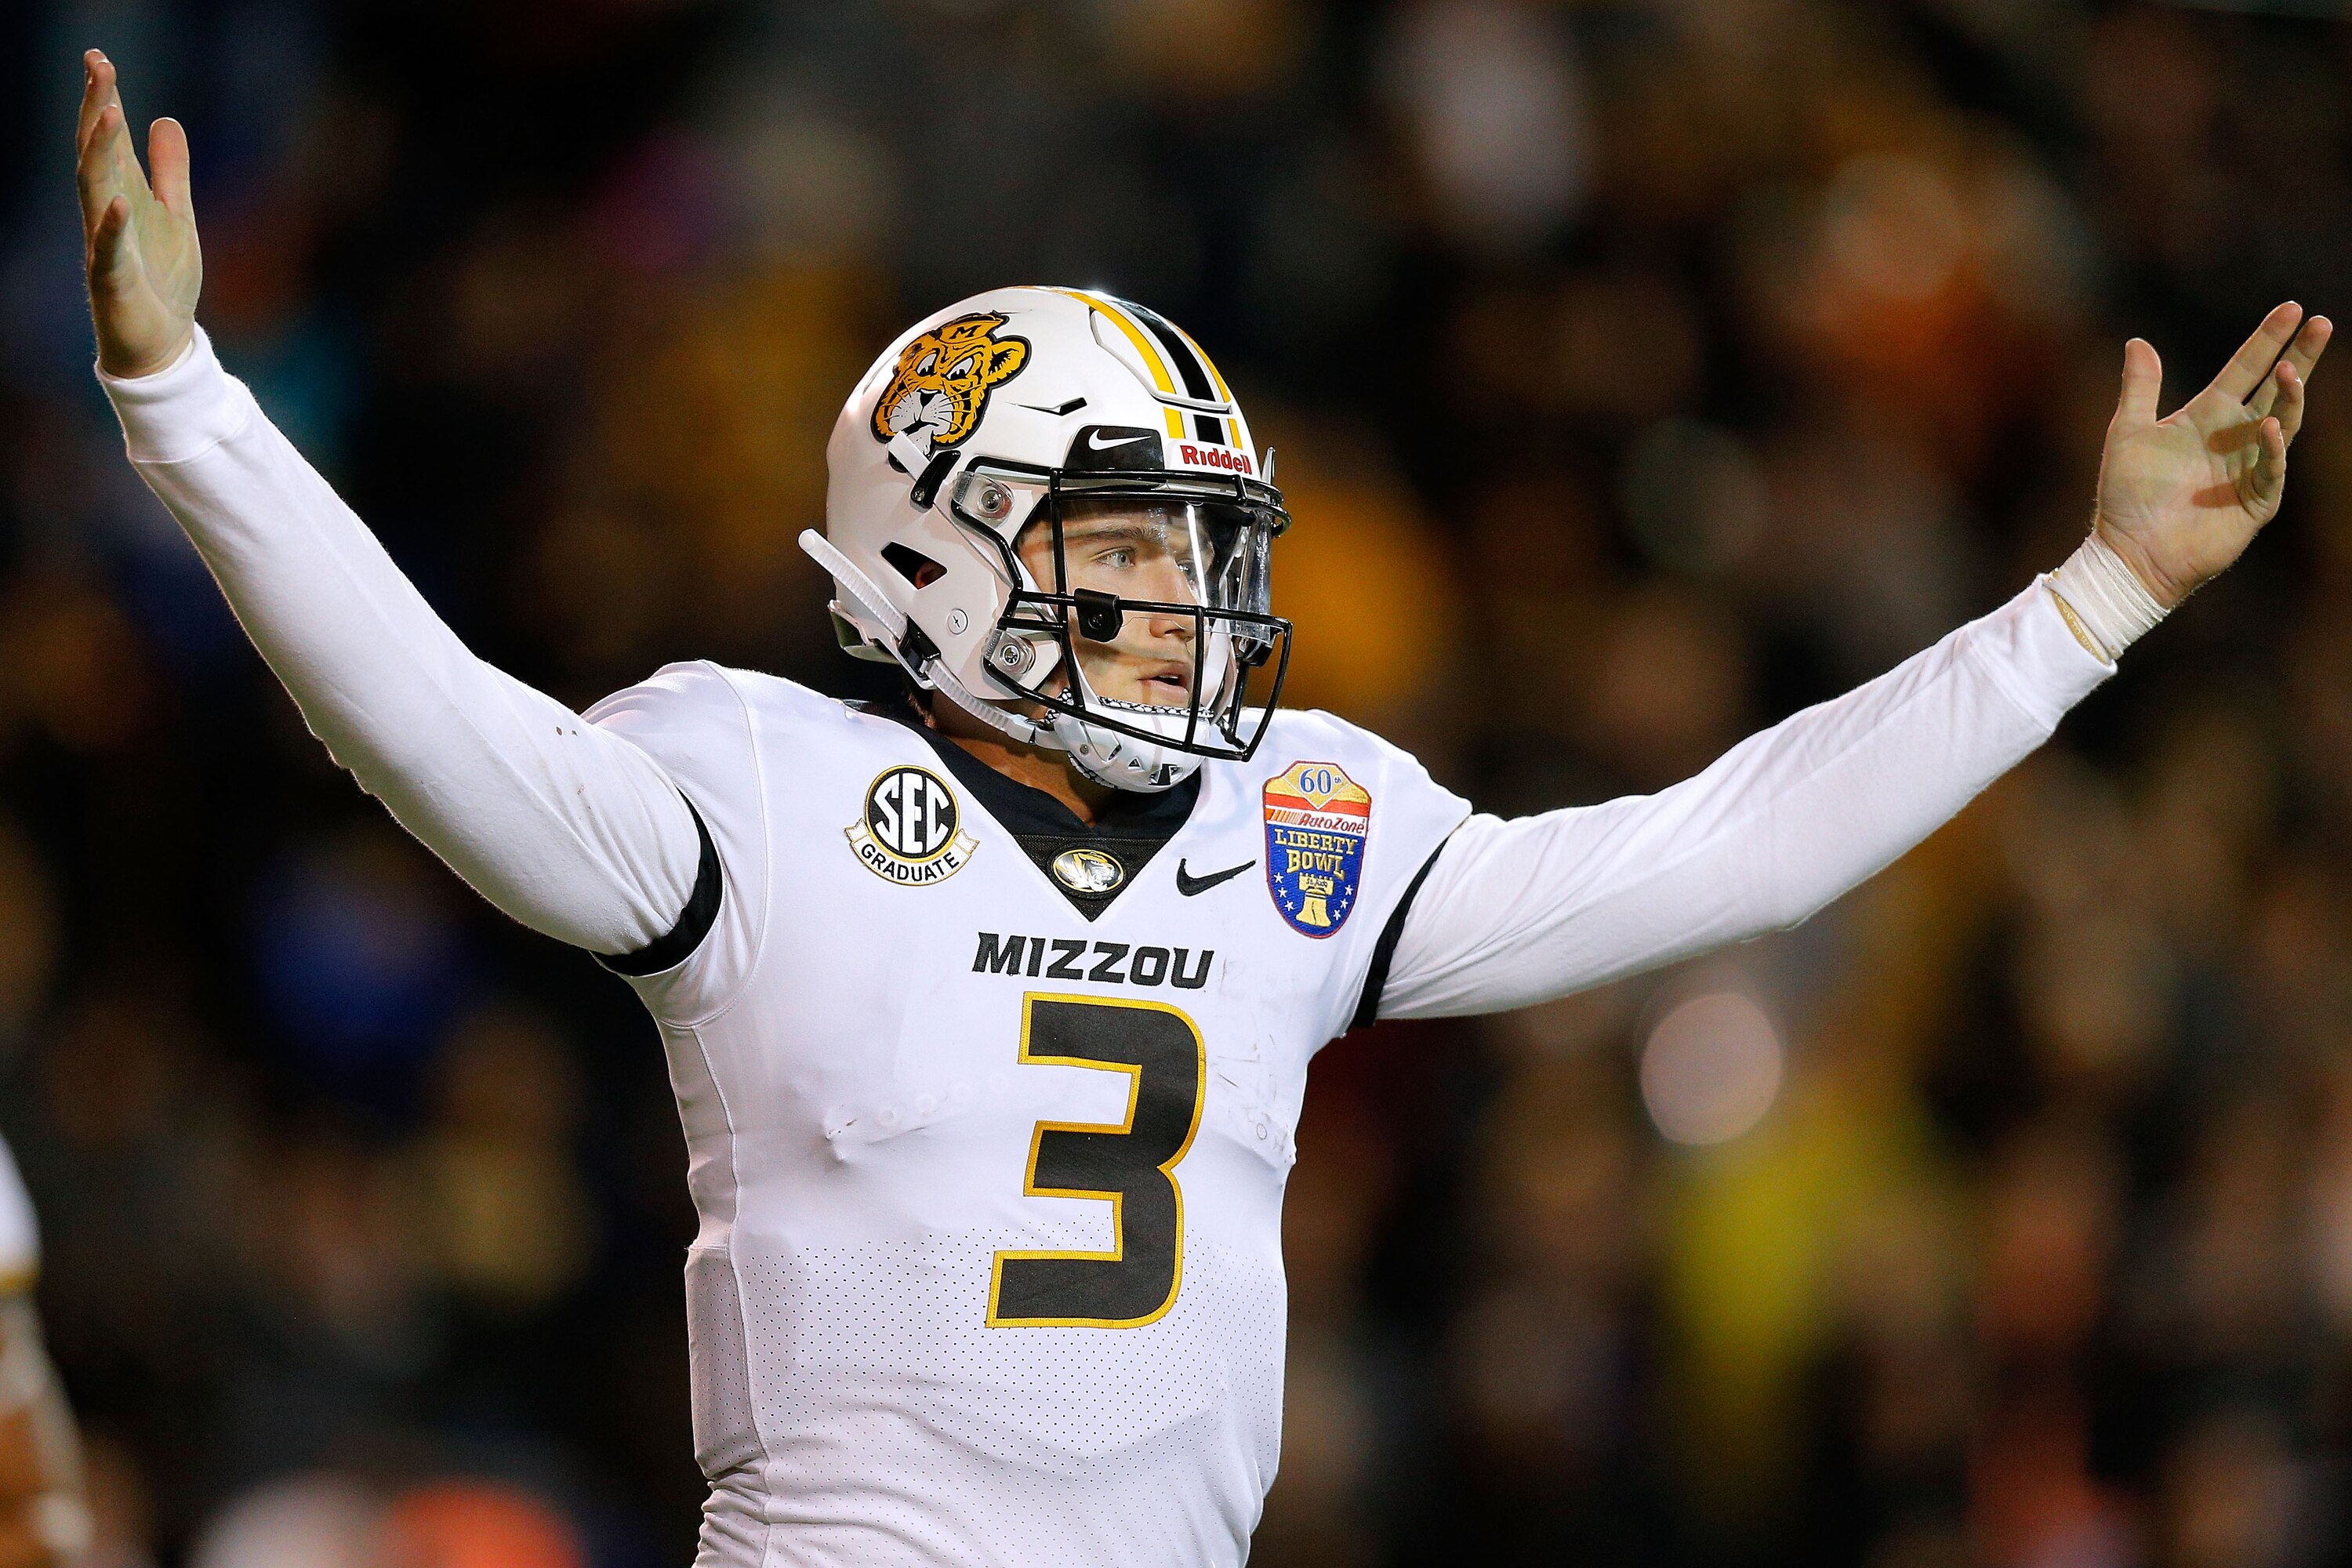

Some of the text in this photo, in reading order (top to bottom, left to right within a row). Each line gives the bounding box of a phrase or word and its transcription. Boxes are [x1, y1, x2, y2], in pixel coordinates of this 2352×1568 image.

[1179, 445, 1253, 475] Riddell
[873, 771, 950, 855] SEC
[1298, 812, 1365, 834] AutoZone
[1274, 828, 1358, 855] LIBERTY
[862, 843, 960, 882] GRADUATE
[1287, 848, 1345, 881] BOWL
[971, 931, 1214, 989] MIZZOU
[985, 990, 1207, 1328] 3
